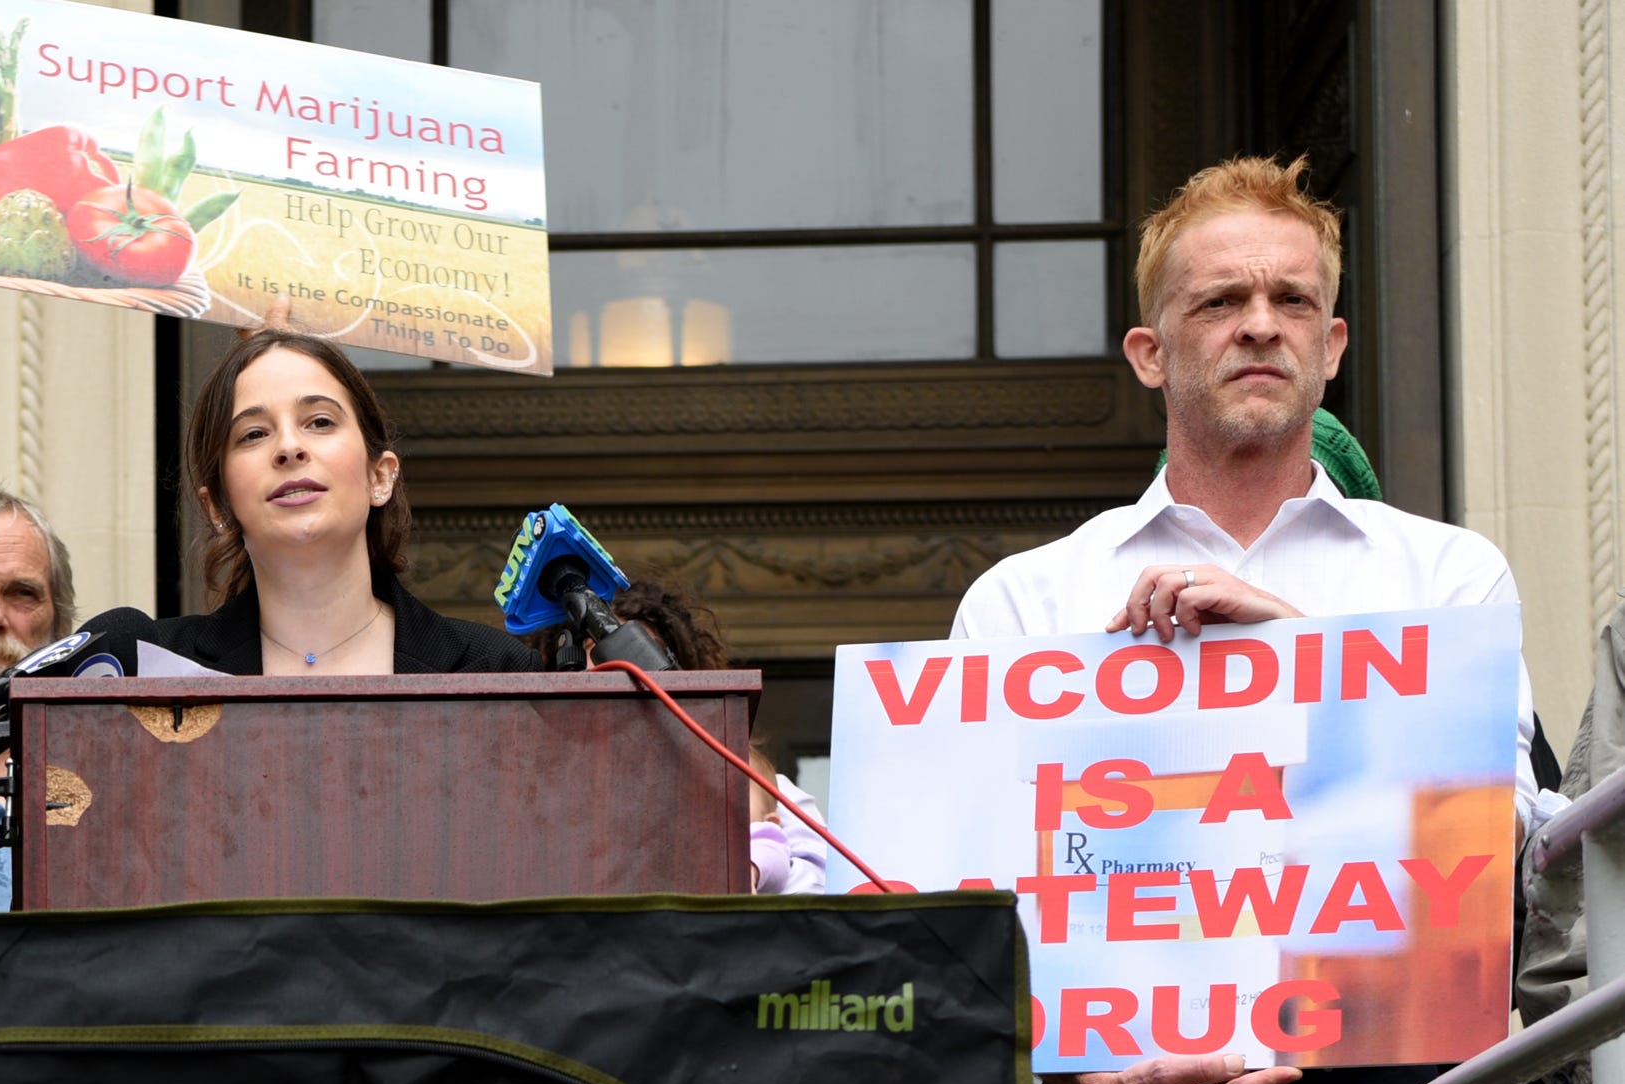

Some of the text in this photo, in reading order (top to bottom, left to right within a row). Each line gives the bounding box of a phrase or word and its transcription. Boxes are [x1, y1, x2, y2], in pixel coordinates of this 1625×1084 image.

[38, 43, 504, 154] Support Marijuana
[286, 136, 489, 211] Farming
[284, 194, 510, 255] Help Grow Our
[237, 273, 510, 331] It is the Compassionate
[359, 247, 510, 301] Economy!
[370, 318, 512, 354] Thing To Do
[865, 624, 1429, 727] VICODIN
[1033, 752, 1294, 833] IS A
[1101, 859, 1196, 877] Pharmacy
[845, 855, 1494, 944] TEWAY
[757, 979, 914, 1032] milliard
